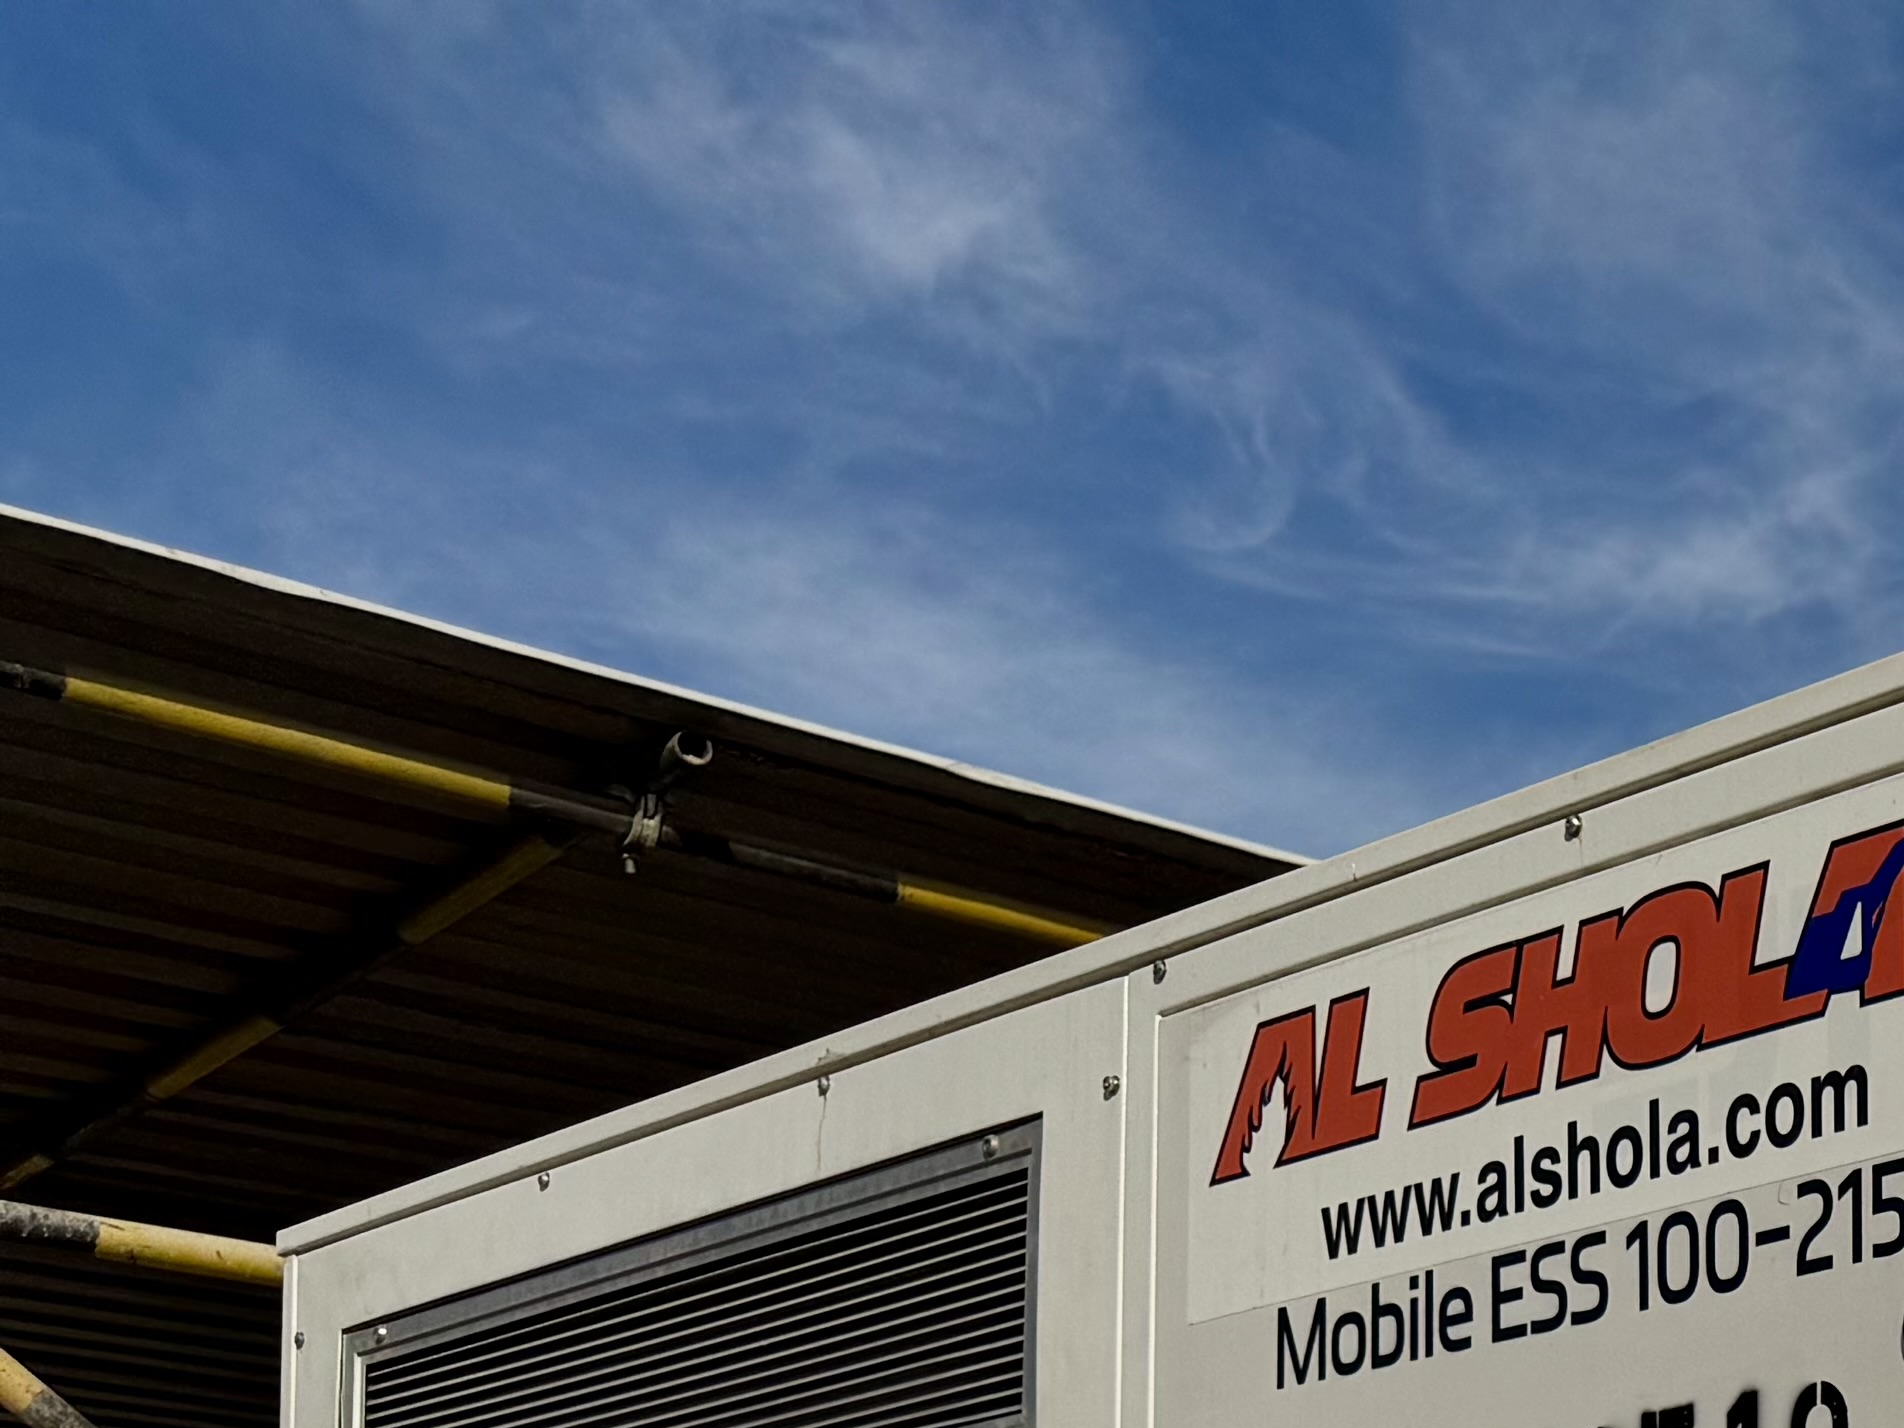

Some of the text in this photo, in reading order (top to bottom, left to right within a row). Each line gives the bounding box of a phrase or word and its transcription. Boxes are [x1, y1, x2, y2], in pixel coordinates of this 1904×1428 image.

[1210, 990, 1387, 1186] AL
[1322, 1064, 1869, 1260] www.alshola.com
[1275, 1270, 1473, 1390] Mobile
[1491, 1230, 1609, 1343] ESS
